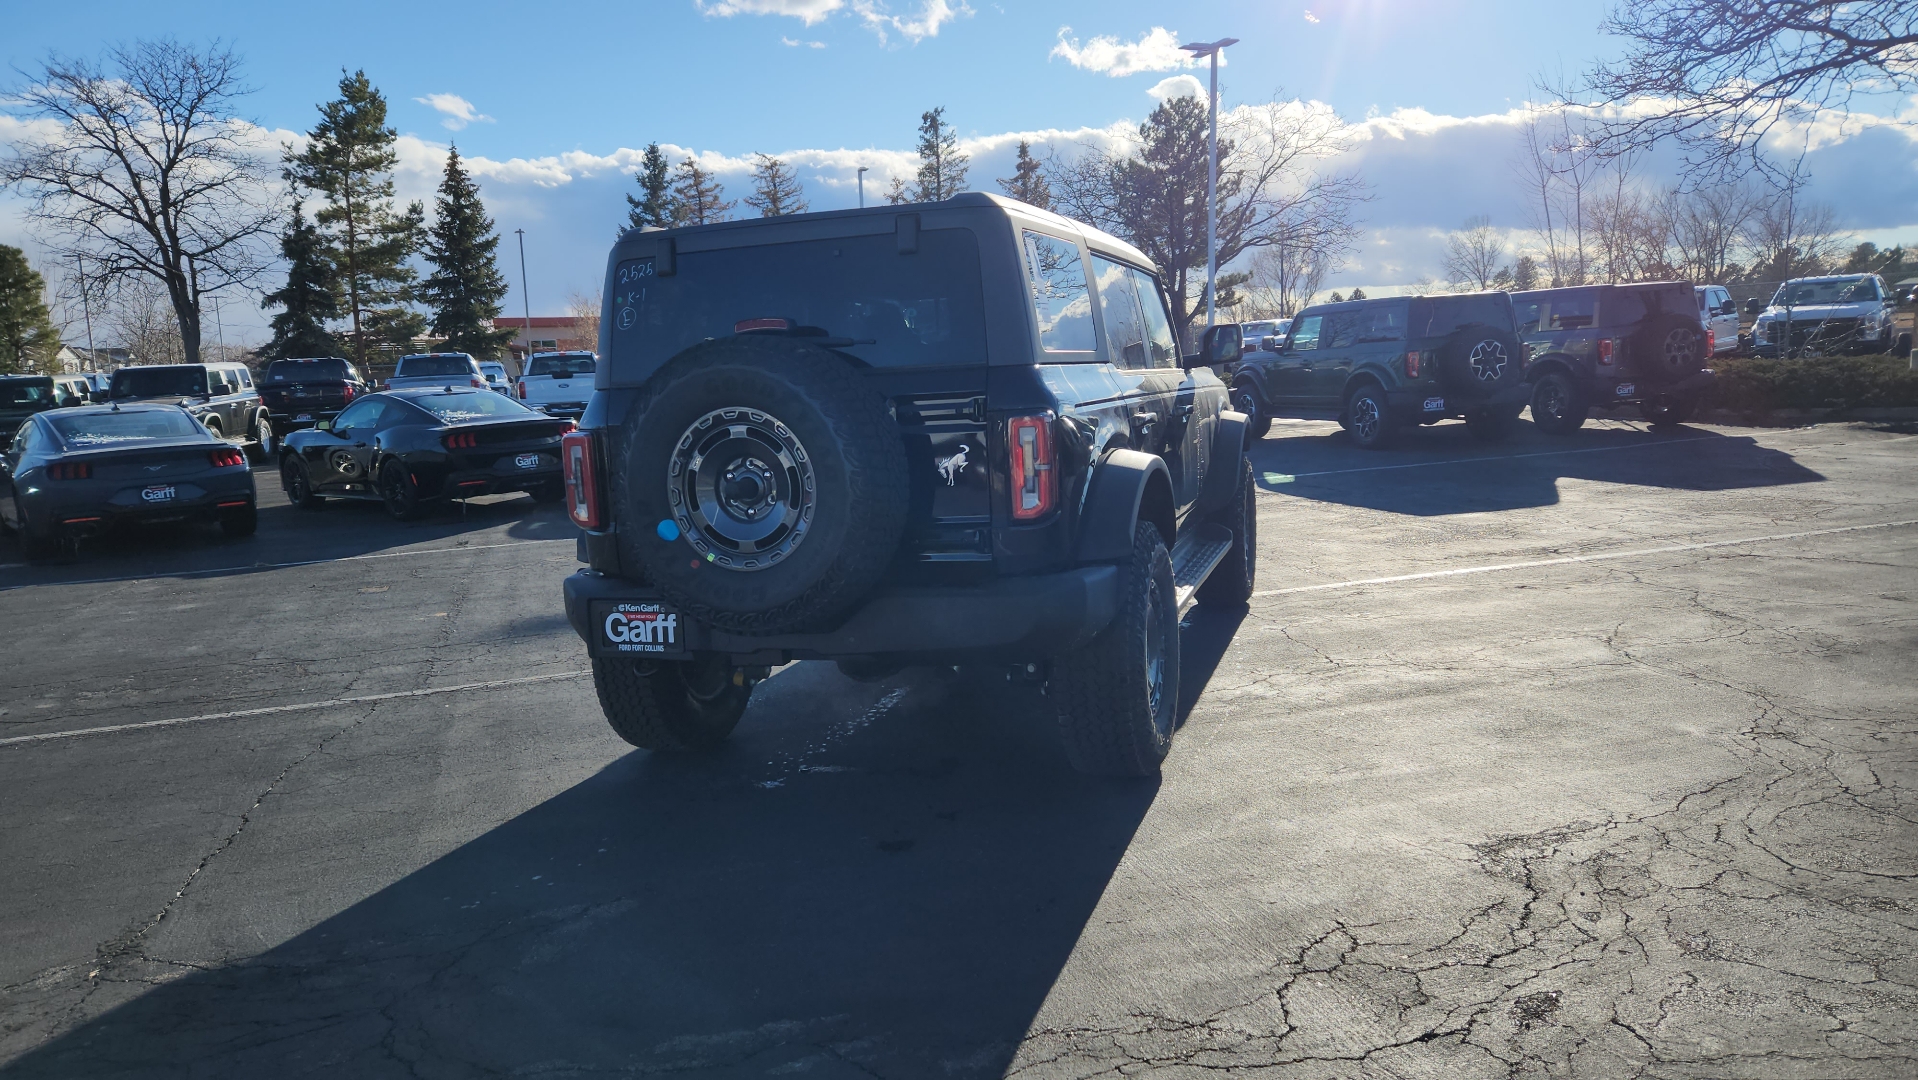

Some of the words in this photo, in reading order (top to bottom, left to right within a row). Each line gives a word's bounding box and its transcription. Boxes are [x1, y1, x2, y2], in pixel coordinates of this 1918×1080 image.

[619, 262, 653, 284] 2525
[515, 455, 539, 467] Garff
[141, 487, 176, 500] Garff
[625, 604, 640, 612] Ken
[640, 604, 659, 612] Garff
[605, 612, 677, 643] Garff
[618, 644, 631, 652] FORD
[632, 644, 644, 652] FORT
[644, 645, 665, 653] COLLINS
